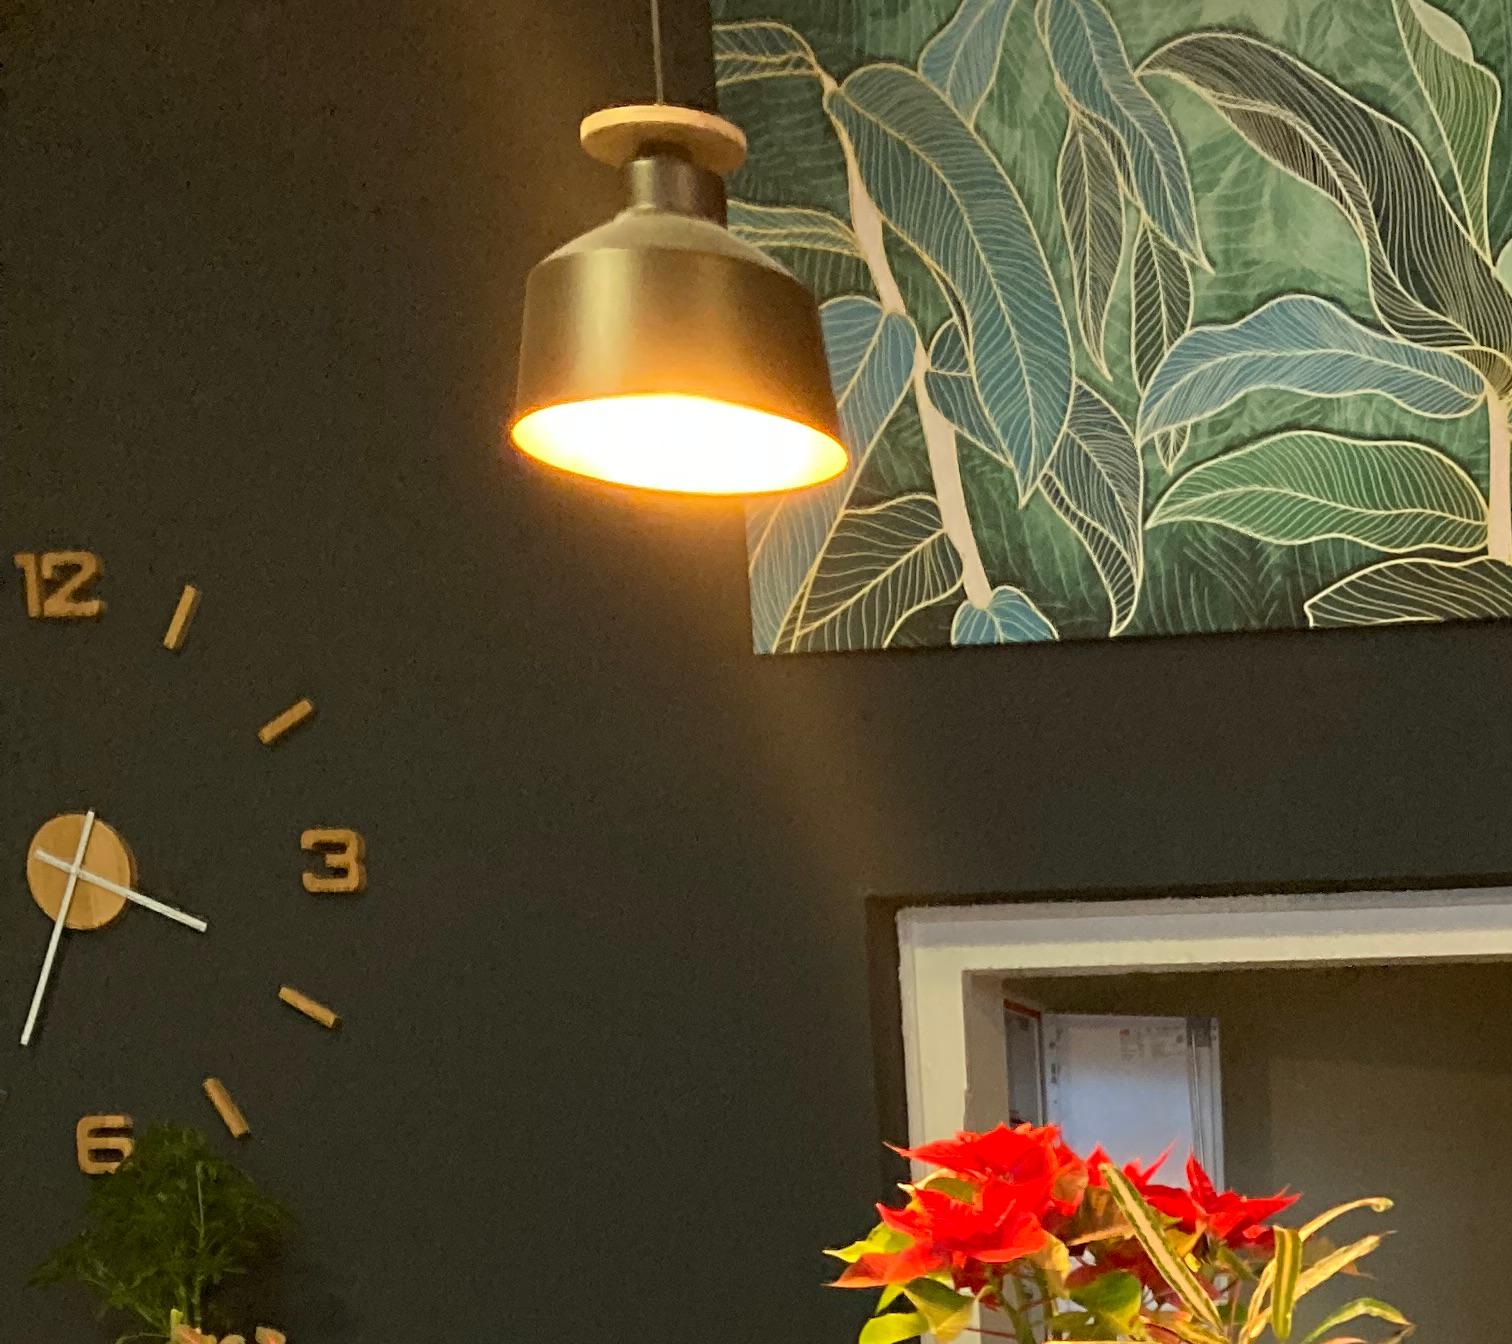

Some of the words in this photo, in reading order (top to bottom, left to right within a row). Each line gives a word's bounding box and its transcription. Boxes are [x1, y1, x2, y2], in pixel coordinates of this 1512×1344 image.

[14, 551, 105, 619] 12
[301, 828, 364, 893] 3
[75, 1114, 134, 1174] 6
